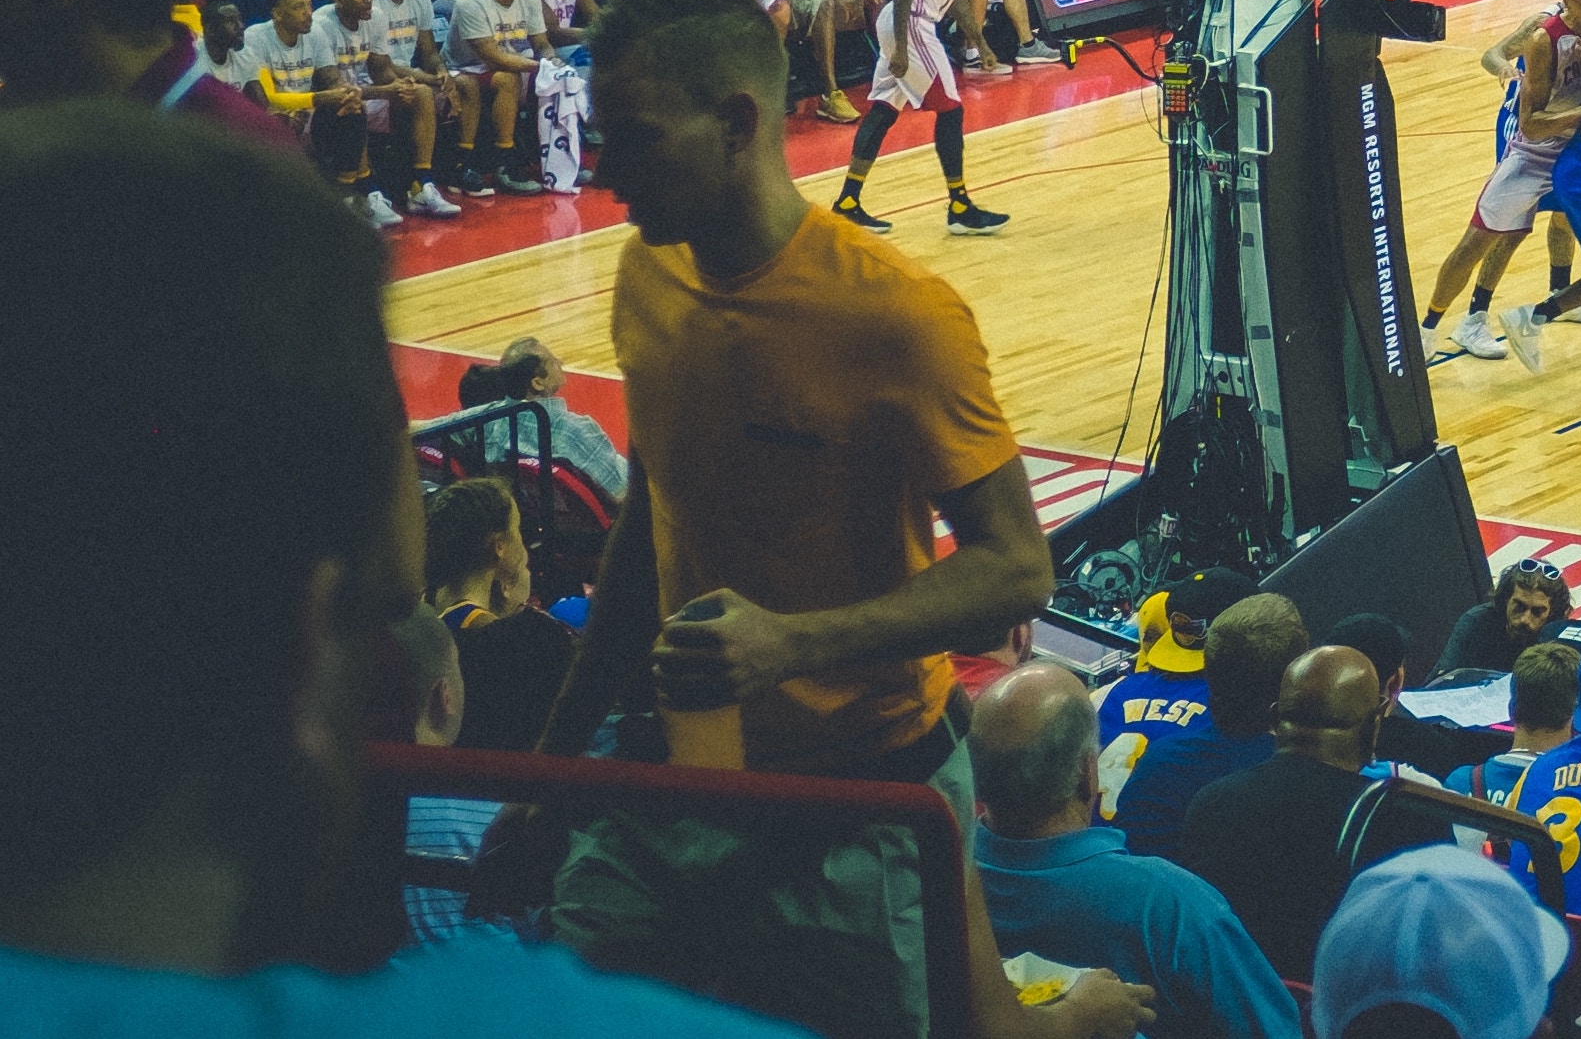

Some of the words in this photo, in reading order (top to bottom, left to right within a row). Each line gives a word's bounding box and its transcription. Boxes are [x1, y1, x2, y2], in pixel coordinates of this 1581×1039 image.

[1360, 83, 1377, 130] MGM
[1364, 134, 1385, 221] RESORTS
[1122, 698, 1207, 726] WEST
